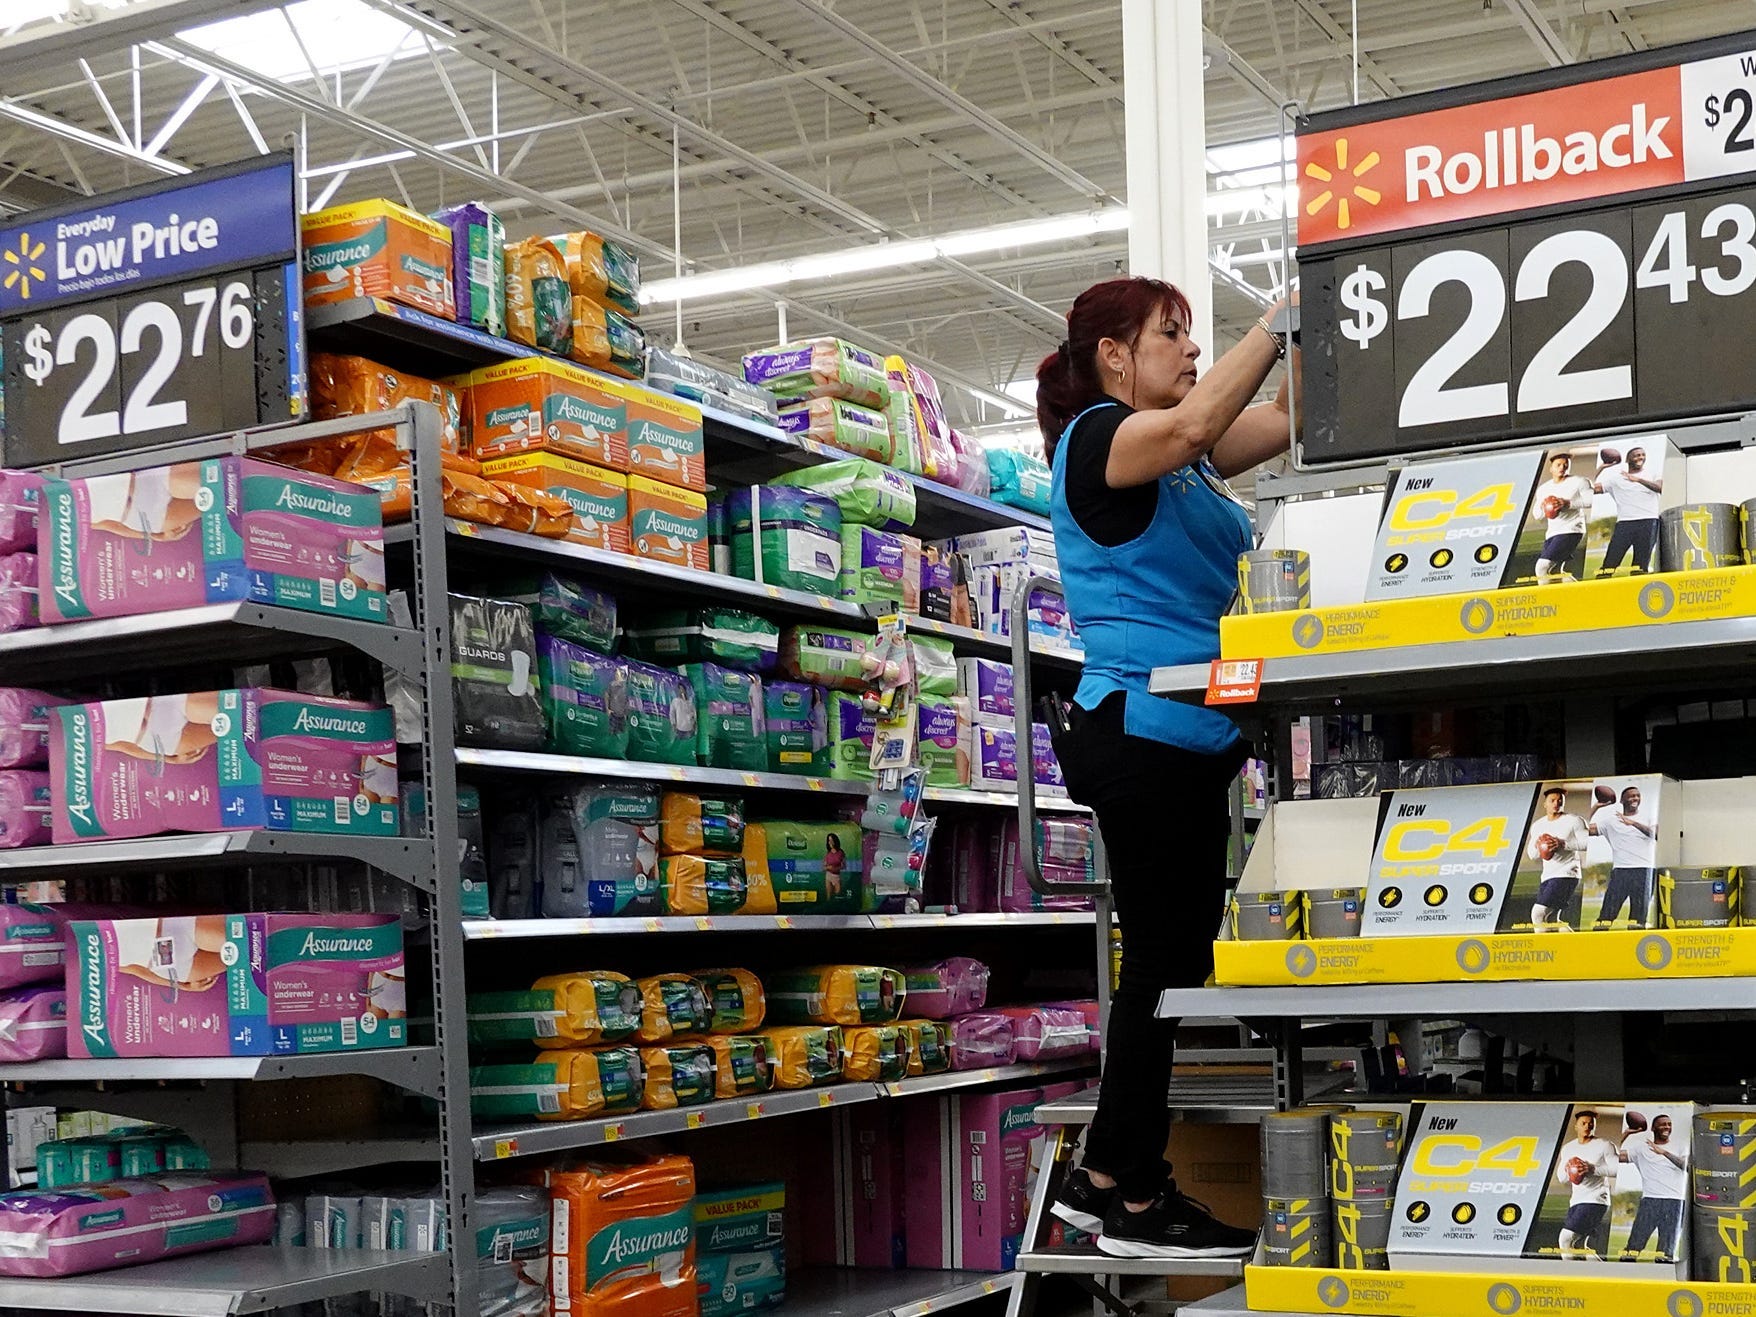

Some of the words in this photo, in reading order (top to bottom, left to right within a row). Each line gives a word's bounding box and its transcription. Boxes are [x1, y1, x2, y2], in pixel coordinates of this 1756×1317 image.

[1404, 102, 1674, 203] Rollback
[305, 214, 333, 226] VALUE
[332, 211, 353, 222] PACK
[57, 215, 116, 239] Everyday
[421, 222, 441, 235] PACK
[57, 237, 126, 281] Low
[131, 213, 219, 264] Price
[485, 367, 508, 379] VALUE
[509, 363, 529, 375] PACK
[565, 370, 586, 384] VALUE
[586, 376, 604, 389] PACK
[557, 396, 617, 429] Assurance
[645, 396, 665, 409] VALUE
[665, 402, 683, 414] PACK
[489, 408, 530, 426] Assurance
[638, 423, 695, 452] Assurance
[484, 460, 507, 474] VALUE
[508, 457, 528, 469] PACK
[564, 461, 585, 475] VALUE
[585, 466, 604, 479] PACK
[1405, 478, 1434, 491] New
[276, 484, 352, 517] Assurance
[652, 485, 670, 498] VALUE
[670, 490, 688, 502] PACK
[1388, 482, 1517, 532] C4
[645, 511, 698, 539] Assurance
[54, 493, 78, 607] Assurance
[105, 541, 115, 600] underwear
[256, 574, 265, 586] L
[1677, 576, 1728, 591] STRENGTH
[1496, 595, 1537, 607] SUPPORTS
[1679, 589, 1723, 605] POWER
[1326, 609, 1380, 622] PERFORMANCE
[1497, 604, 1558, 621] HYDRATION
[1327, 622, 1366, 637] ENERGY
[459, 645, 506, 662] GUARDS
[1219, 687, 1255, 698] Rollback
[293, 707, 367, 734] Assurance
[231, 739, 239, 780] MAXIMUM
[268, 751, 303, 764] Women's
[68, 713, 92, 826] Assurance
[268, 761, 309, 773] underwear
[112, 771, 121, 821] Women's
[120, 762, 129, 820] underwear
[608, 799, 648, 814] Assurance
[1397, 803, 1427, 818] New
[1381, 815, 1511, 863] C4
[1375, 916, 1398, 924] ENERGY
[1416, 914, 1448, 922] HYDRATION
[299, 931, 373, 956] Assurance
[1491, 939, 1535, 950] SUPPORTS
[1675, 934, 1726, 945] STRENGTH
[1319, 943, 1375, 954] PERFORMANCE
[1493, 949, 1554, 964] HYDRATION
[1677, 946, 1721, 960] POWER
[1320, 954, 1359, 968] ENERGY
[83, 934, 105, 1046] Assurance
[274, 980, 308, 990] Women's
[274, 990, 315, 999] underwear
[124, 994, 134, 1044] Women's
[133, 985, 141, 1044] underwear
[363, 1016, 375, 1026] 54
[235, 1031, 245, 1041] L
[280, 1028, 288, 1040] L
[302, 1035, 334, 1044] MAXIMUM
[1428, 1116, 1458, 1131] New
[1331, 1119, 1354, 1200] C4
[1410, 1134, 1541, 1178] C4
[705, 1202, 735, 1216] VALUE
[736, 1199, 760, 1210] PACK
[709, 1224, 759, 1246] Assurance
[1442, 1232, 1475, 1240] HYDRATION
[600, 1225, 690, 1266] Assurance
[1350, 1278, 1406, 1290] PERFORMANCE
[1522, 1285, 1565, 1295] SUPPORTS
[1352, 1289, 1391, 1302] ENERGY
[1524, 1295, 1585, 1309] HYDRATION
[1708, 1302, 1752, 1315] POWER
